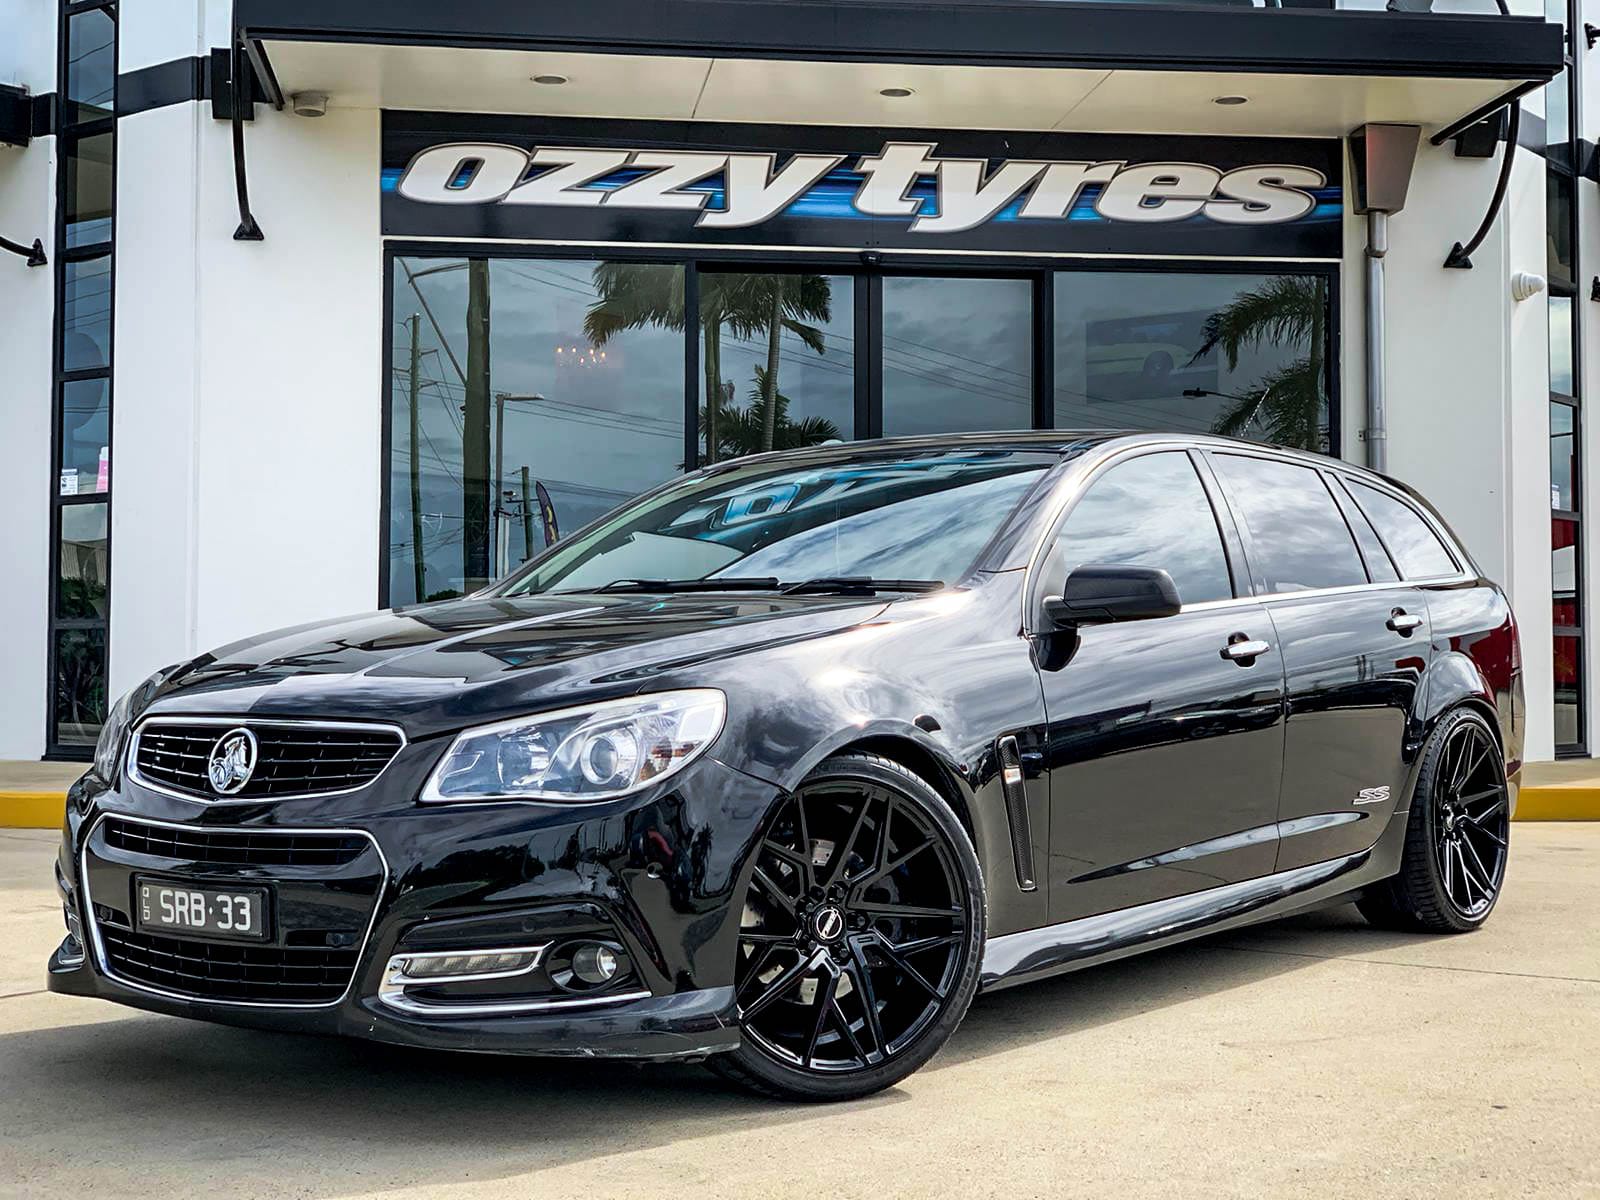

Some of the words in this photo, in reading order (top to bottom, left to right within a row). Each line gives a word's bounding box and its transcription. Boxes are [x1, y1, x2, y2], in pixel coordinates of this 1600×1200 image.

[399, 142, 847, 228] ozzy
[854, 140, 1327, 232] tyres
[1353, 785, 1391, 805] SS
